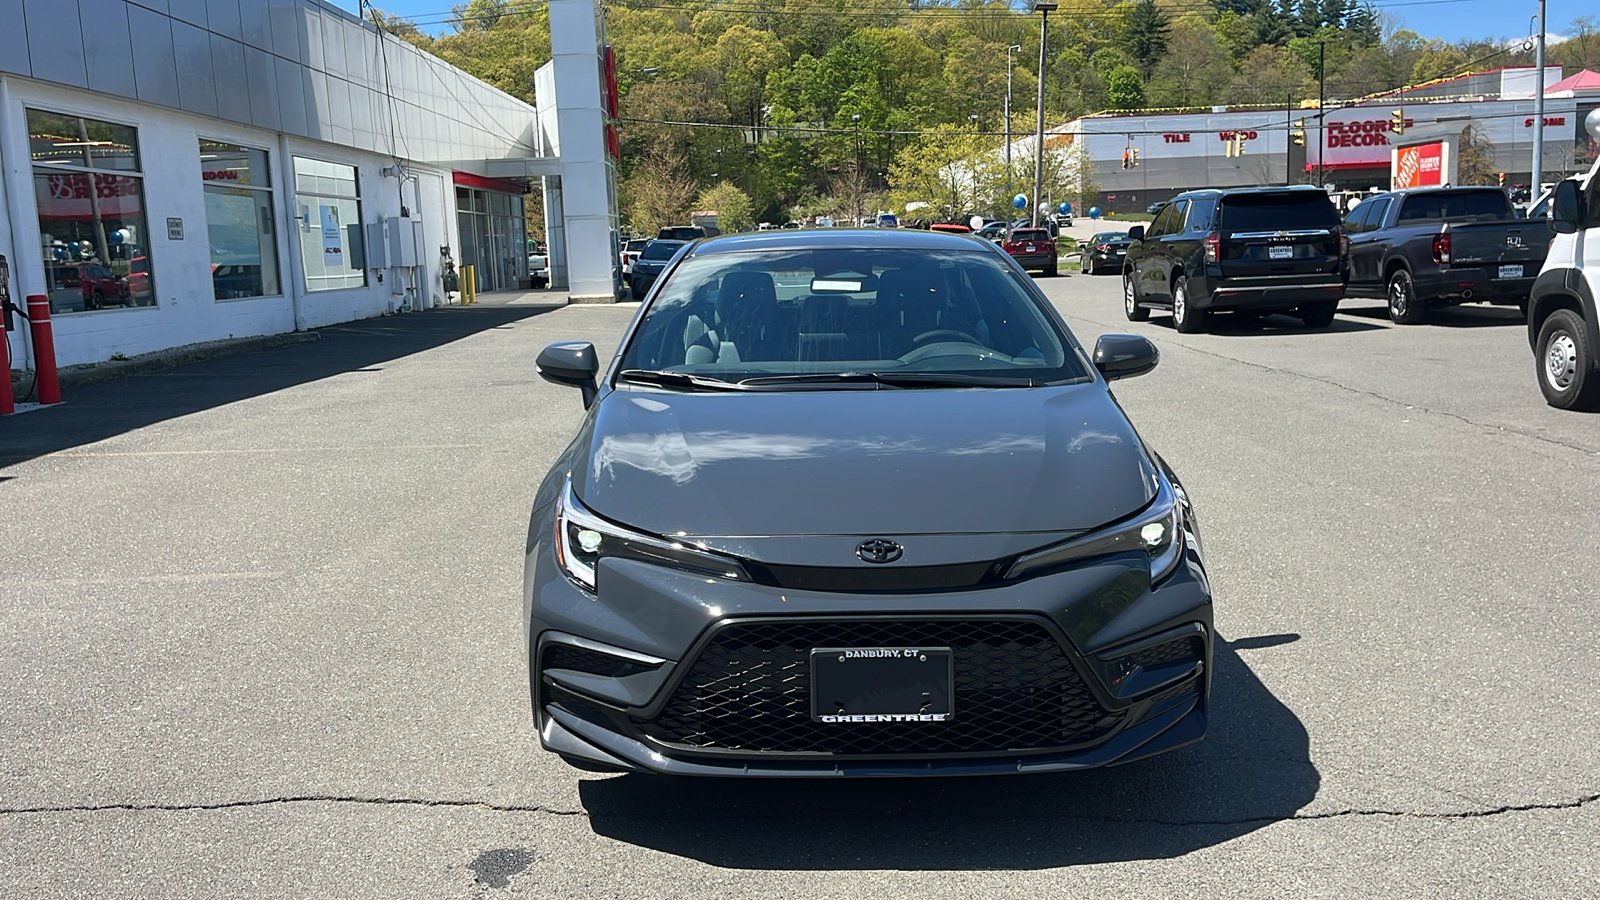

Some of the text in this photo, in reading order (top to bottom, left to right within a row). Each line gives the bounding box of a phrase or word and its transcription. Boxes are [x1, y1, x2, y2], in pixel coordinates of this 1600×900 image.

[1328, 120, 1388, 134] FLOOR
[1163, 133, 1190, 143] TILE
[1328, 133, 1388, 148] DECOR
[845, 649, 919, 658] DANBURY, CT
[821, 714, 946, 723] GREENTREE
